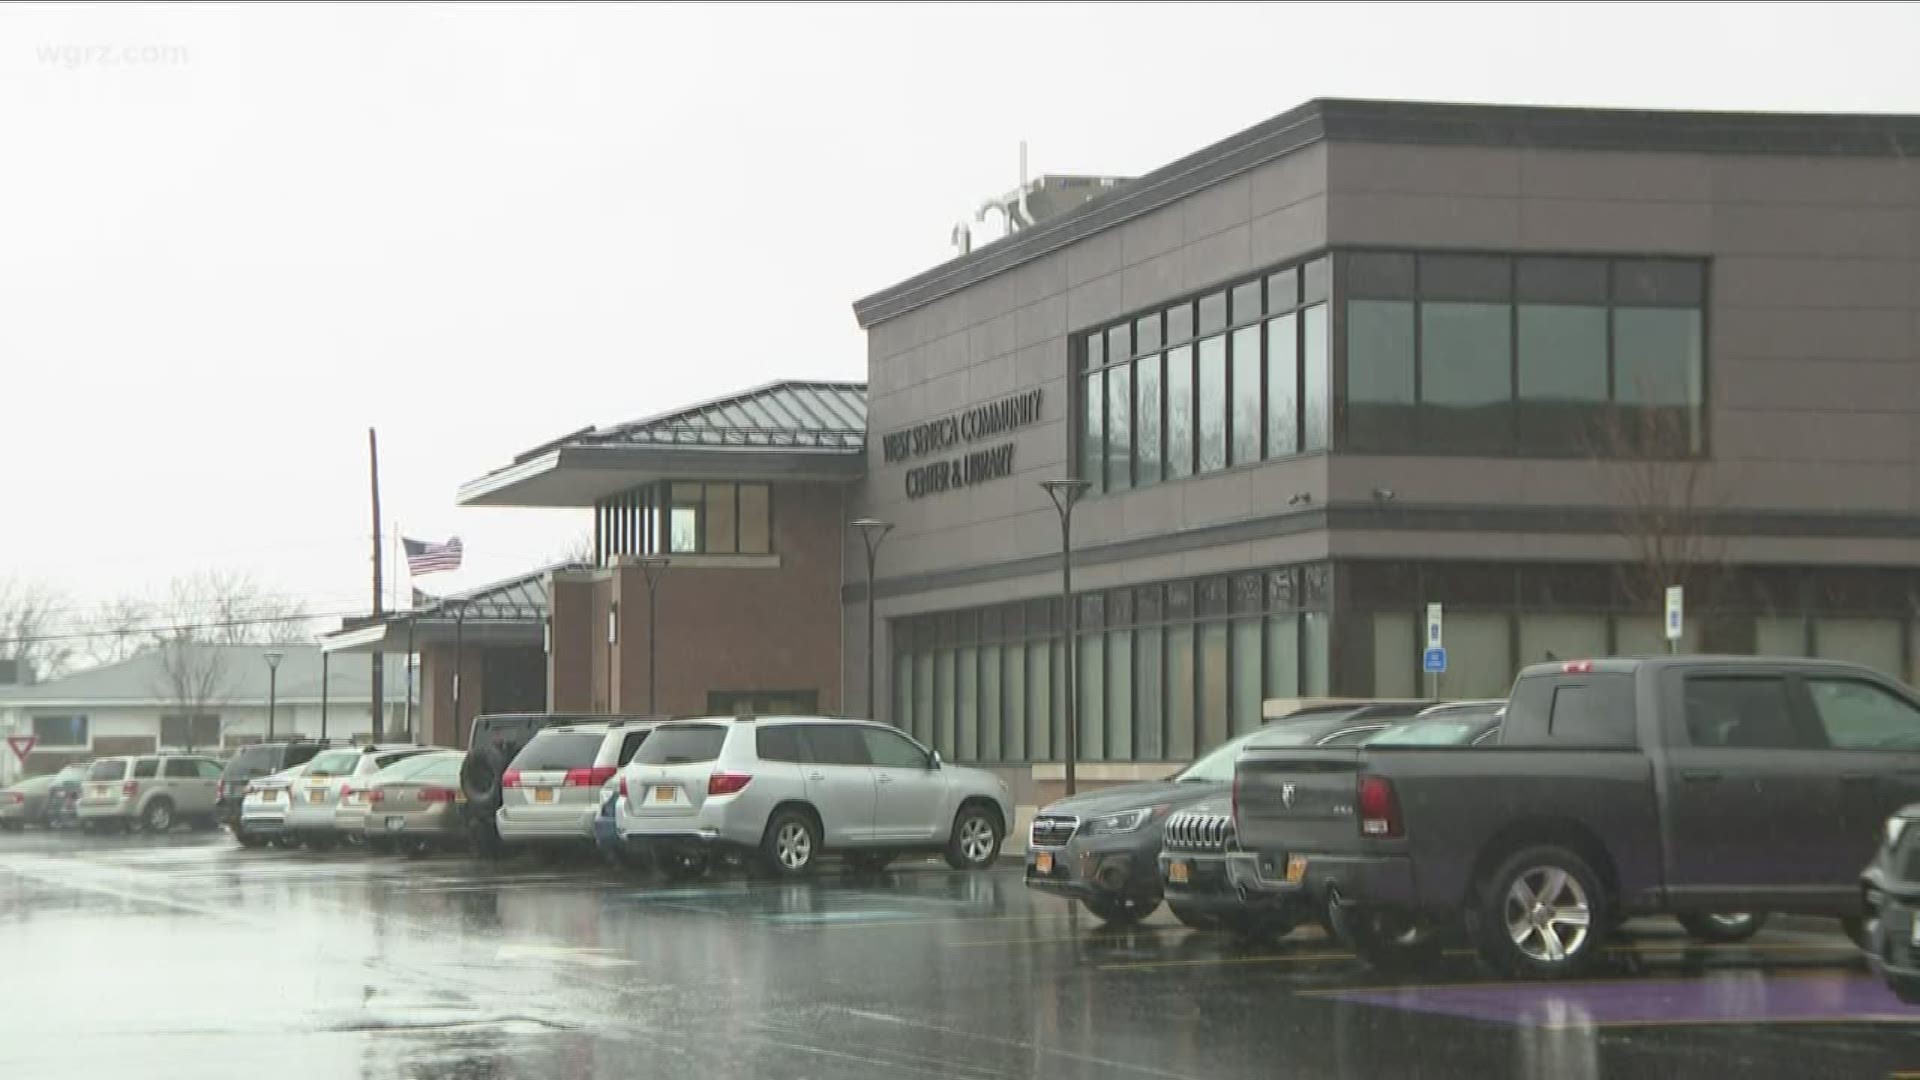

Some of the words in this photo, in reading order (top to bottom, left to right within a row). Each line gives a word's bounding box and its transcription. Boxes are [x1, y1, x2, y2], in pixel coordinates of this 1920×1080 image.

[883, 429, 911, 463] WEST
[913, 414, 960, 456] SENECA
[961, 387, 1042, 441] COMMUNITY
[905, 460, 950, 499] CENTER
[952, 459, 963, 489] &
[964, 443, 1014, 486] LIBRARY
